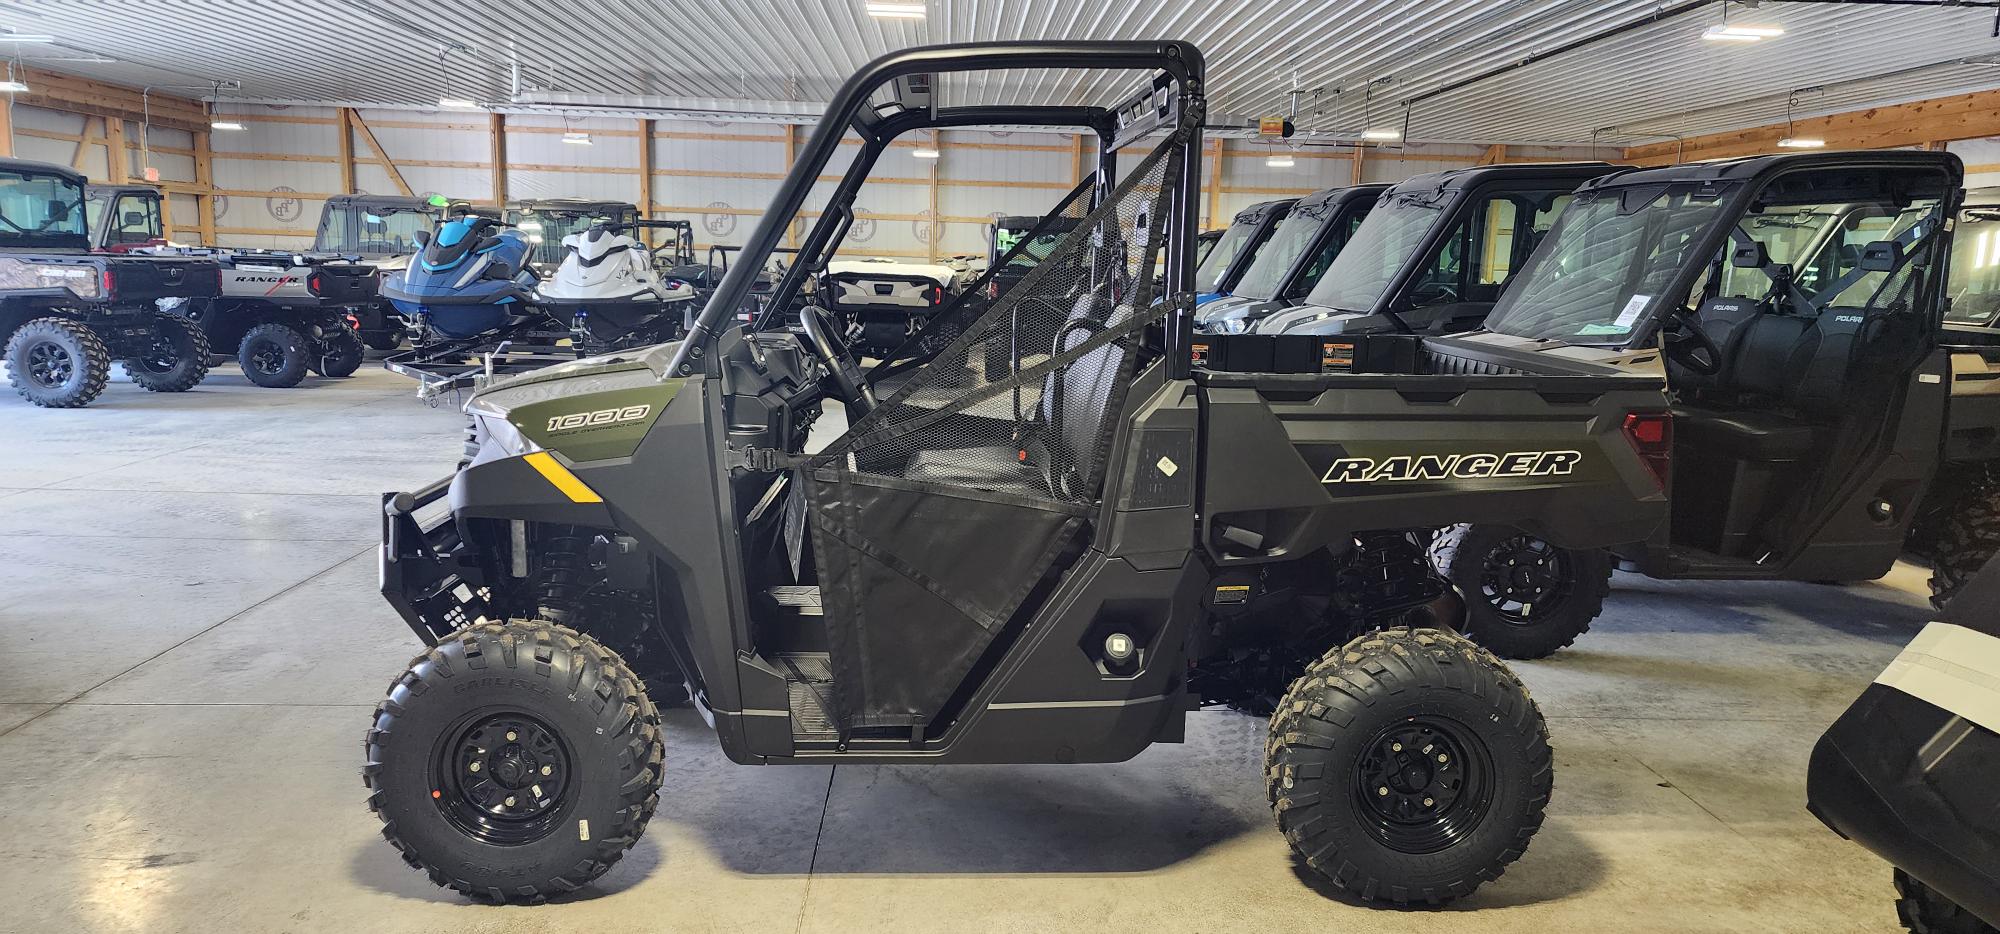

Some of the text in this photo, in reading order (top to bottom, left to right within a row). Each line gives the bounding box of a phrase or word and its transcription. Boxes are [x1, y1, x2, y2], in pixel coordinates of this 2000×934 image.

[1712, 304, 1739, 312] POLARIS
[1834, 315, 1863, 323] POLARI
[546, 404, 650, 432] 1000
[1321, 450, 1582, 483] RANGER
